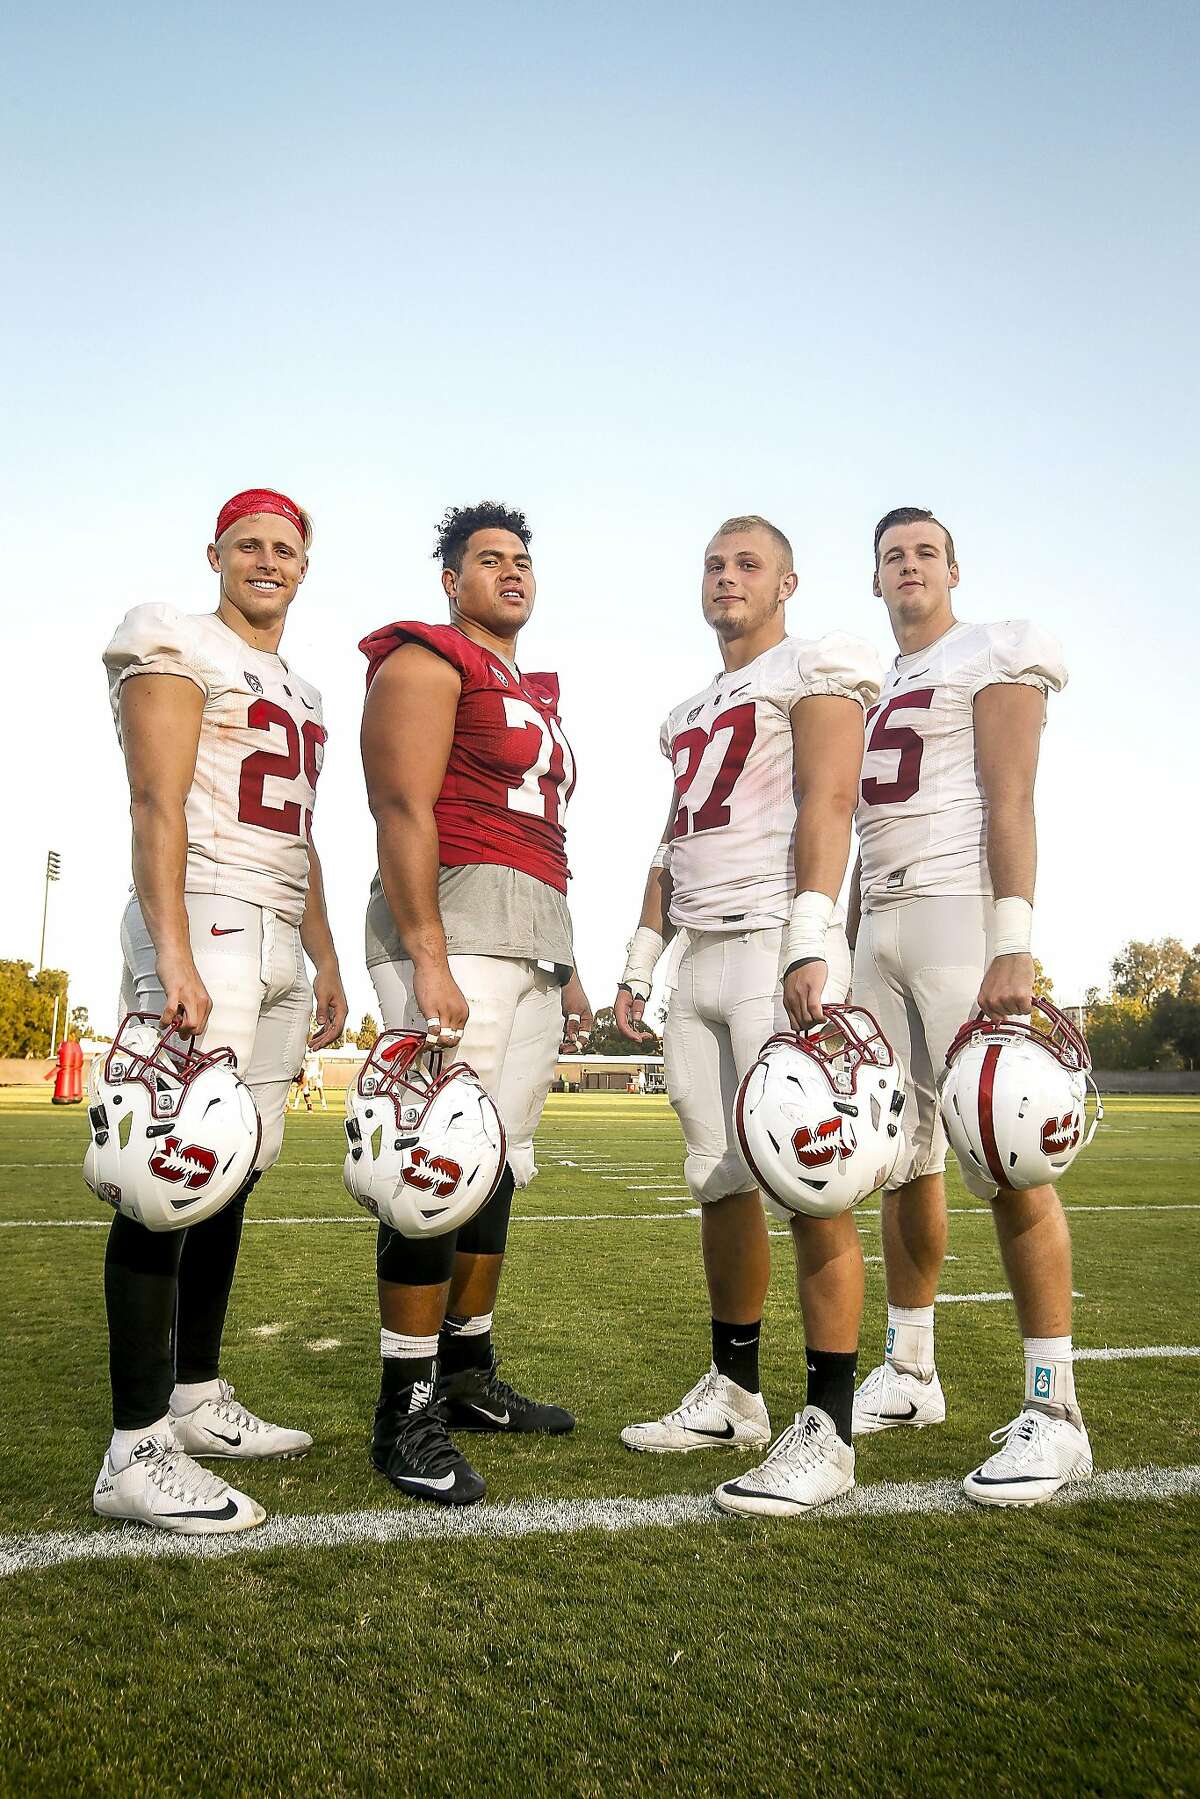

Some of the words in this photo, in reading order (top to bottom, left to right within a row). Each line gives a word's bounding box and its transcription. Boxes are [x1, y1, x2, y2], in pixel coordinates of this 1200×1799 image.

[671, 701, 757, 840] 27
[861, 688, 936, 806] 5
[408, 1380, 431, 1415] NIKE
